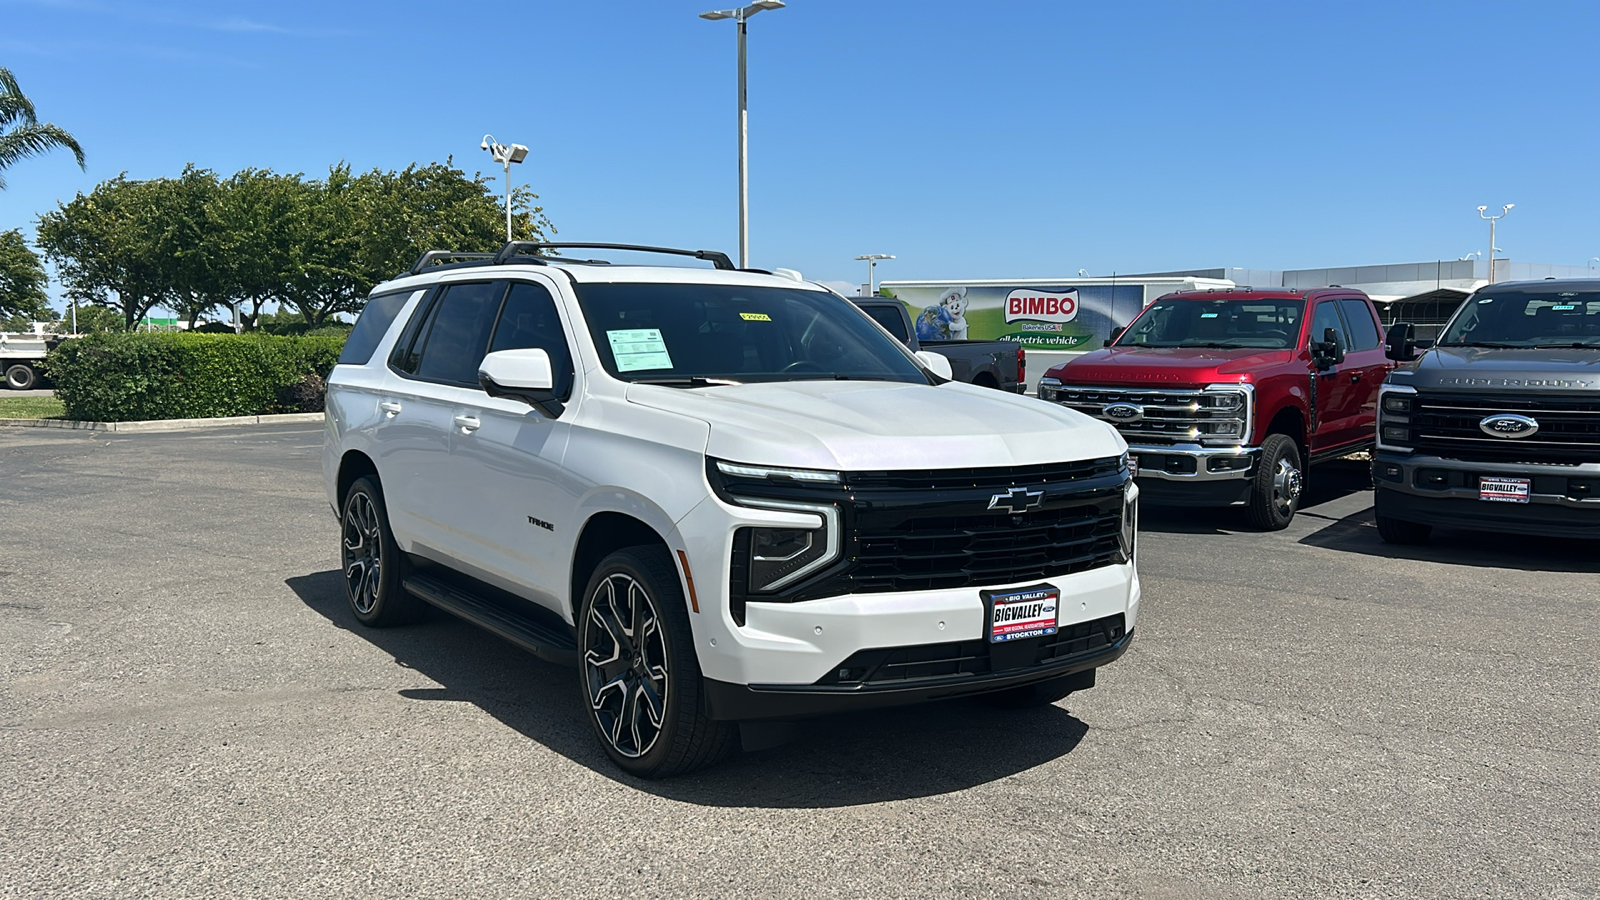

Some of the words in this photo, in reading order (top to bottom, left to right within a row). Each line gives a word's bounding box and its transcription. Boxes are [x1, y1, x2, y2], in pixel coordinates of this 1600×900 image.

[1009, 297, 1075, 315] BIMBO
[1011, 335, 1045, 345] electric
[1046, 336, 1078, 345] vehicle
[1494, 419, 1522, 432] Ford
[1481, 483, 1518, 492] BIGVALLEY
[527, 515, 555, 532] TAHOE
[1021, 592, 1044, 600] VALLEY
[994, 603, 1044, 623] BIGVALLEY
[1006, 629, 1043, 640] STOCKTON
